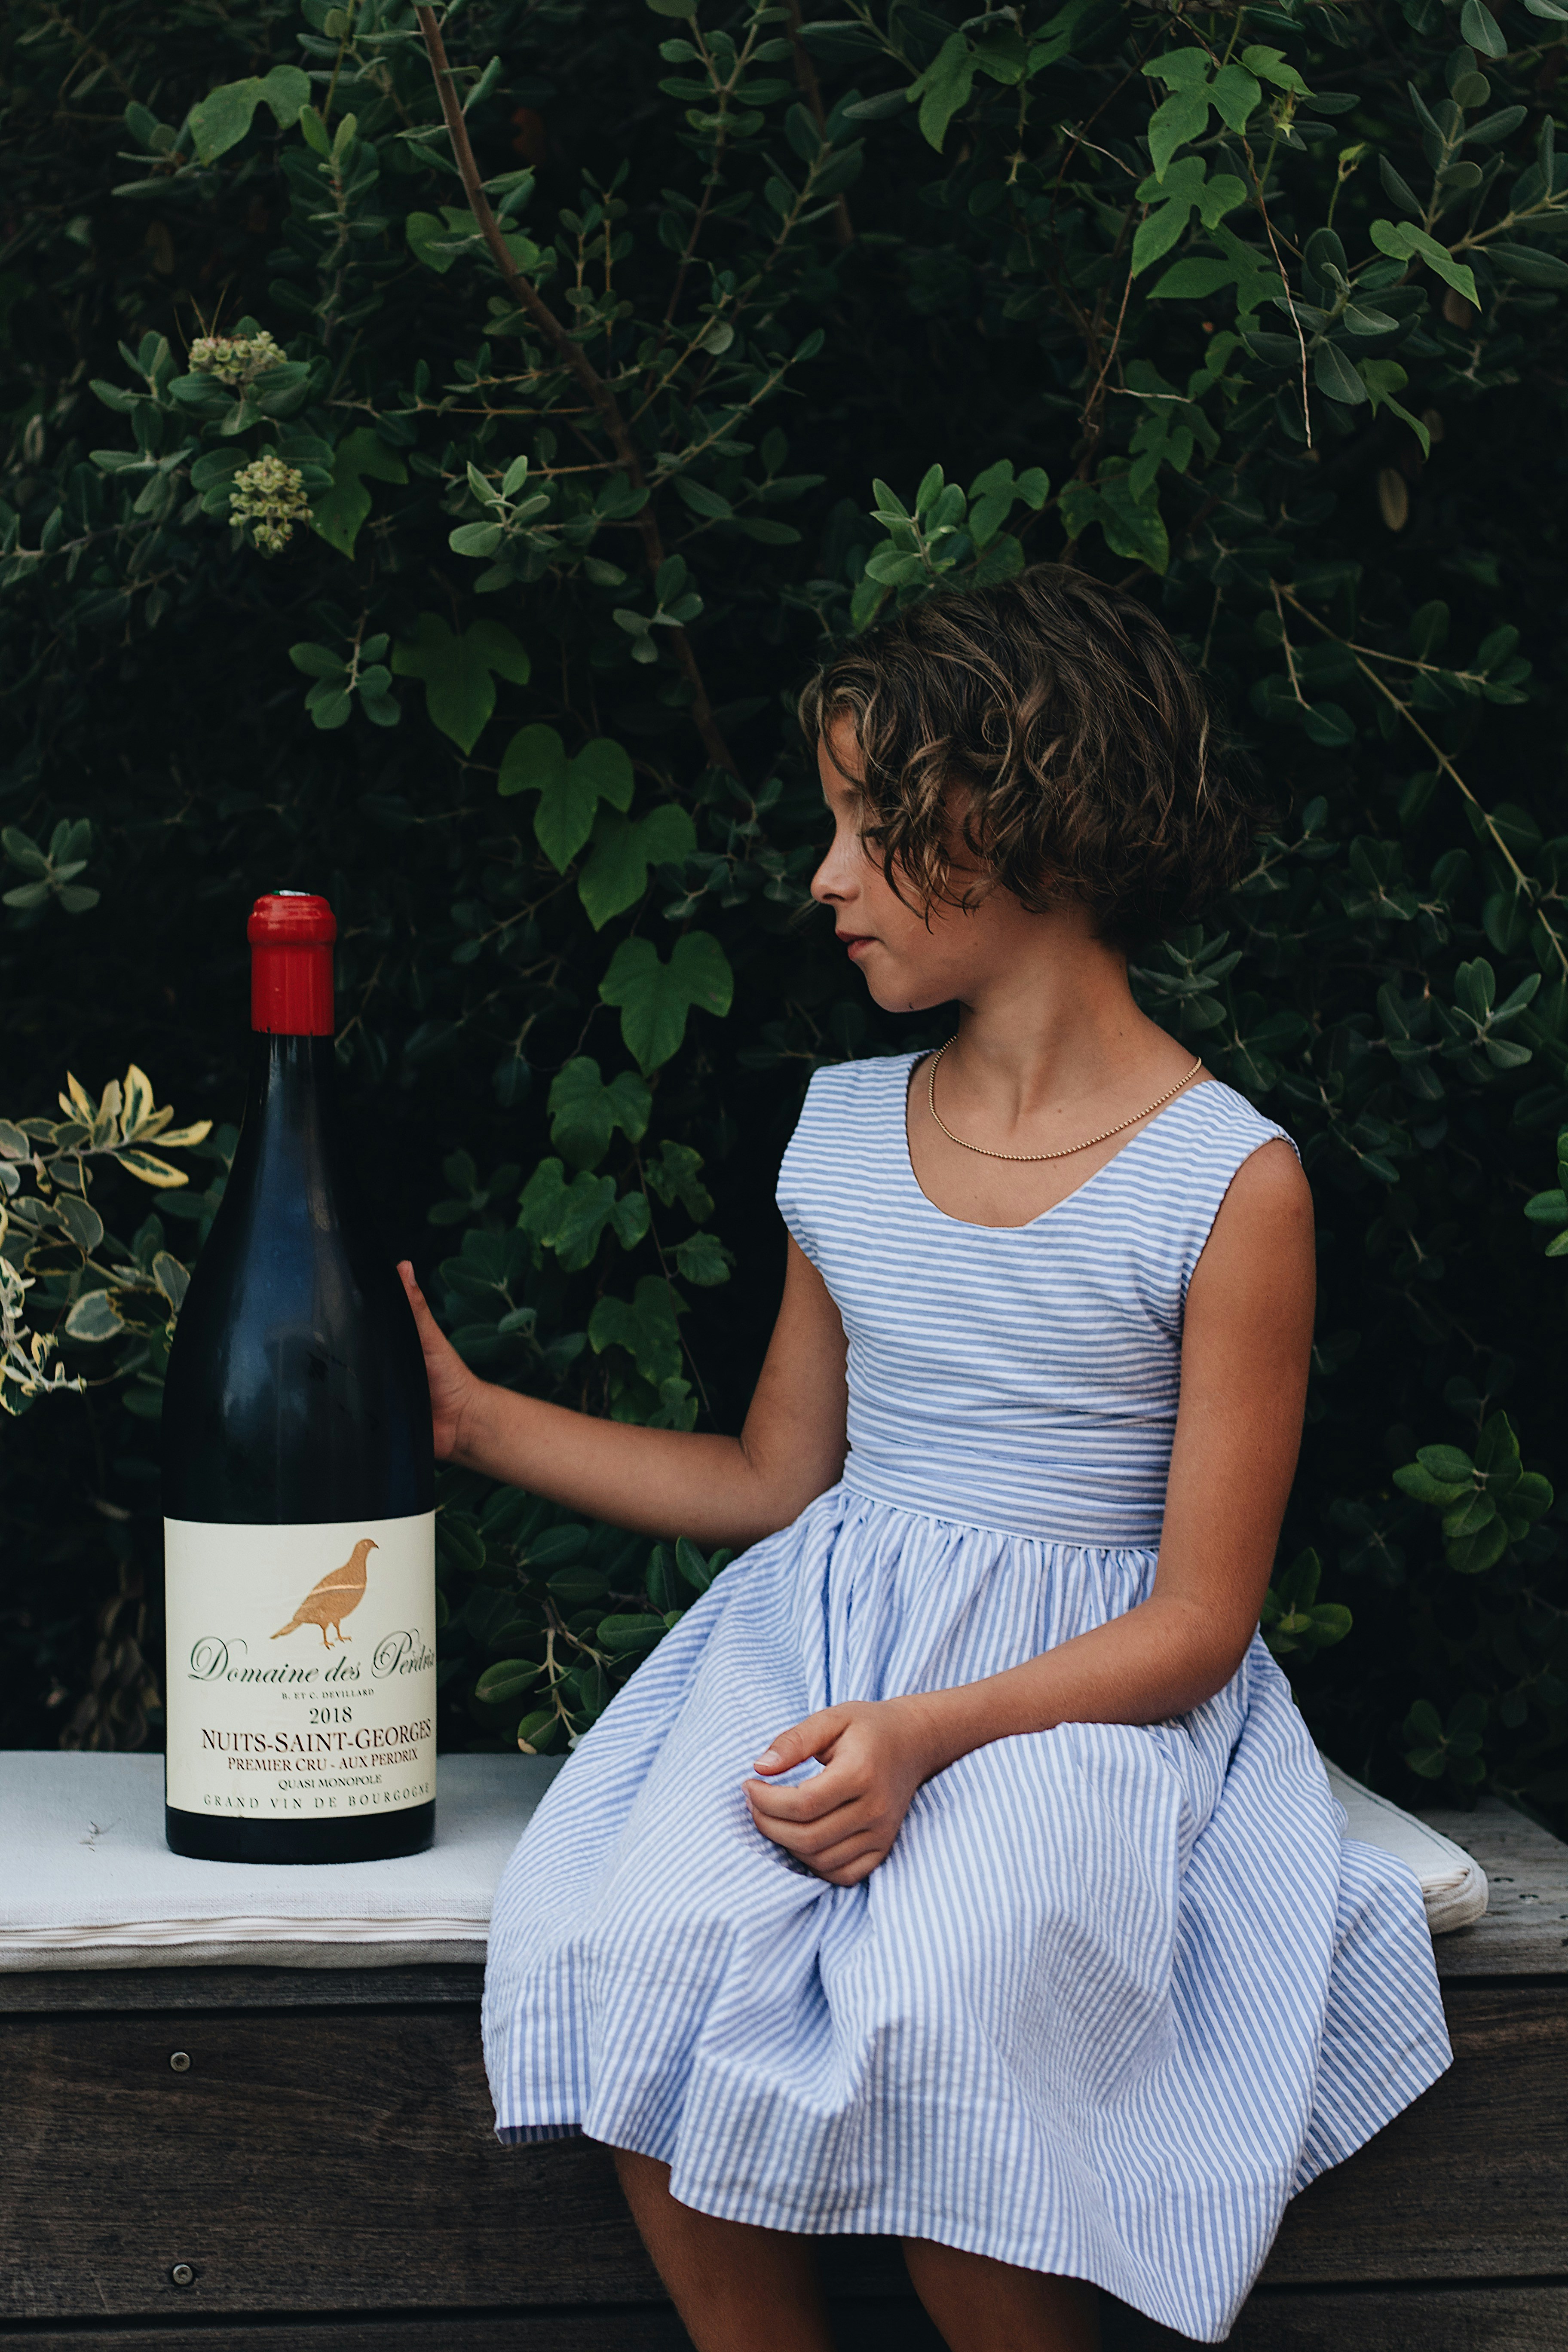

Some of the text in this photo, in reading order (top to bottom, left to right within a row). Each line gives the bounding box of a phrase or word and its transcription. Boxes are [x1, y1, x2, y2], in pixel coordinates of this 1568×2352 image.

[188, 1636, 319, 1684] Domaine
[325, 1656, 360, 1682] des
[322, 1688, 374, 1699] DEVILLARD
[309, 1707, 352, 1724] 2018
[202, 1719, 431, 1752] NUITS-SAINT-GEORGES
[228, 1757, 291, 1771] PREMIER
[296, 1758, 326, 1771] CRU
[339, 1756, 368, 1770] AUX
[371, 1748, 418, 1767] PERDRIX
[279, 1774, 382, 1791] QUASI MONOPOLE
[204, 1783, 430, 1809] GRAND VIN DE BOURGOGNE
